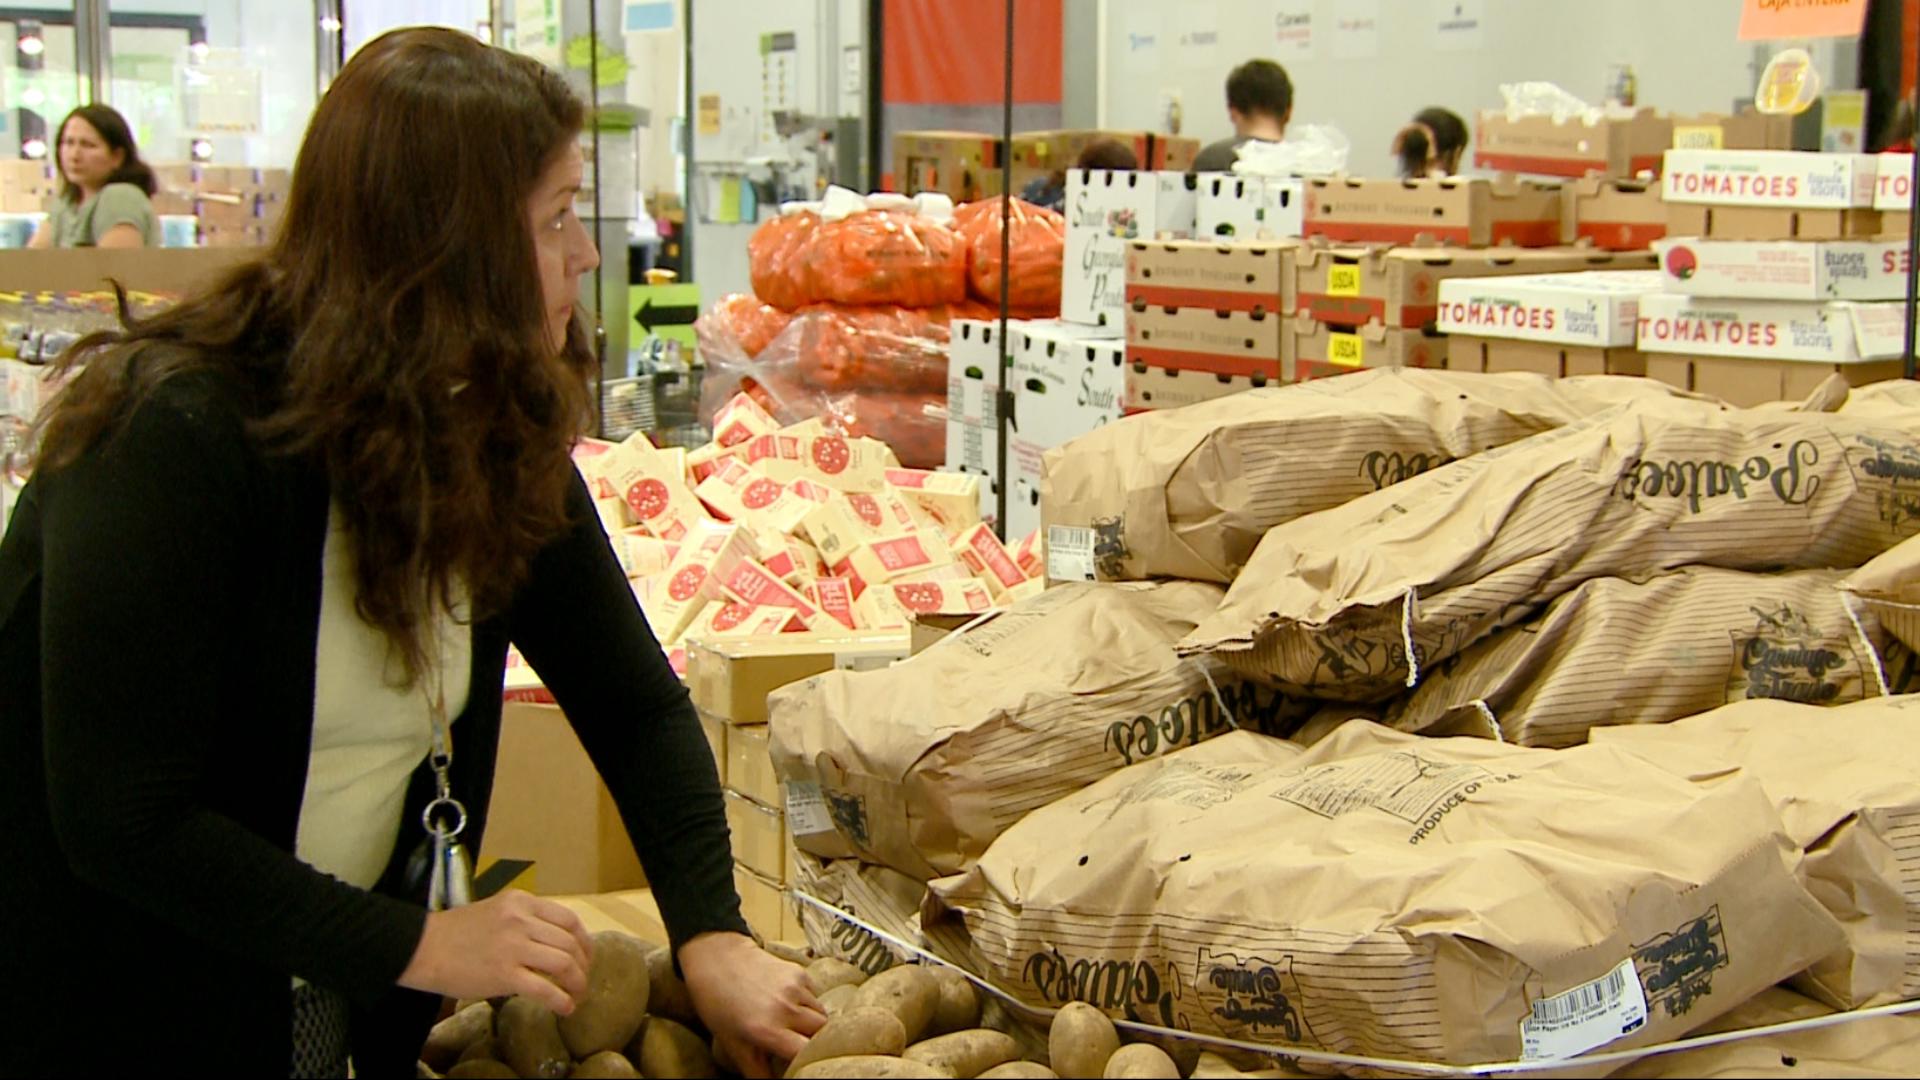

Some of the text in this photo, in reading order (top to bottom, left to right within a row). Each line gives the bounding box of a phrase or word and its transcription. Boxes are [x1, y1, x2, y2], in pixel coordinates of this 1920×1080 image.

[1671, 172, 1798, 197] TOMATOES
[1877, 175, 1909, 196] TO
[1331, 268, 1355, 290] USDA
[1440, 302, 1556, 331] TOMATOES
[1639, 316, 1778, 346] TOMATOES
[1333, 338, 1358, 360] USDA
[1408, 792, 1467, 846] PRODUCE
